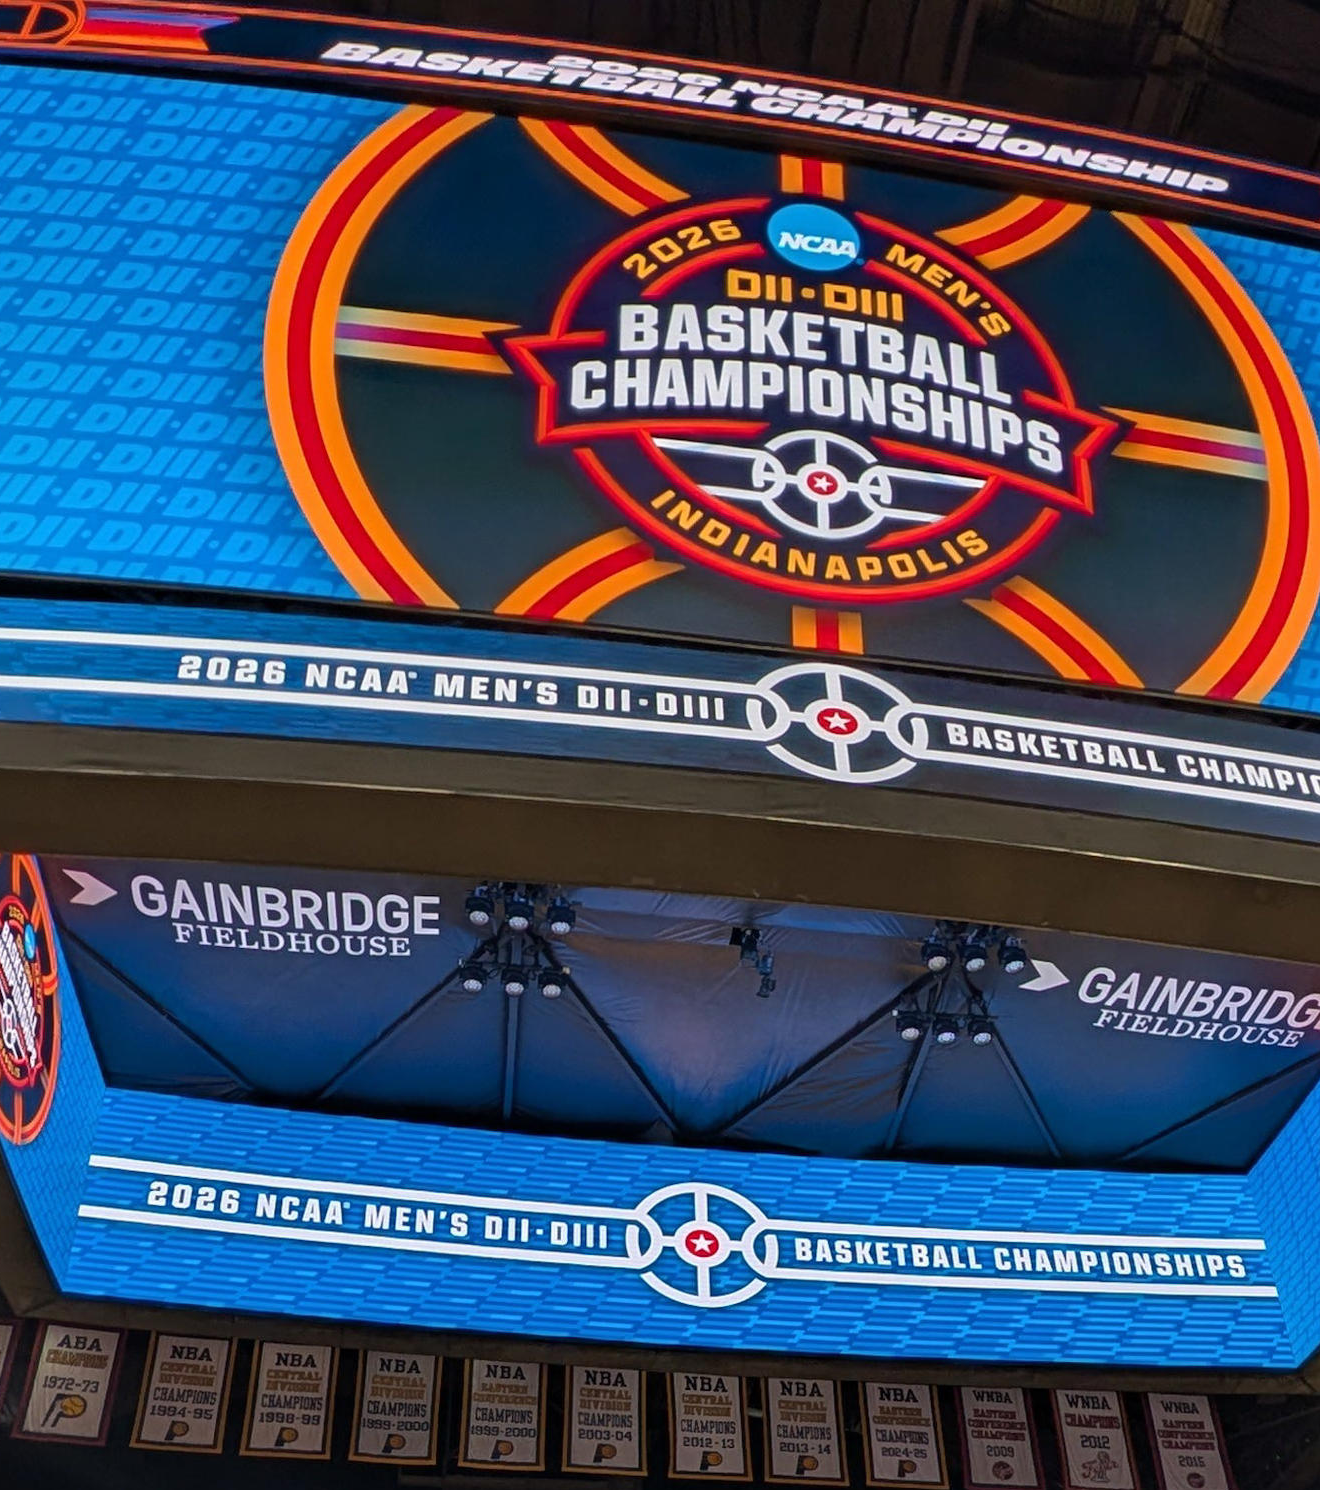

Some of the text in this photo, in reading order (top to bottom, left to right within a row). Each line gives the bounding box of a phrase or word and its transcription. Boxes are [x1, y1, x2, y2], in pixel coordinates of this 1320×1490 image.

[547, 55, 723, 86] 2026
[731, 79, 918, 119] NCAA
[320, 41, 1229, 194] BASKETBALL CHAMPIONSHIP
[623, 219, 742, 280] 2026
[778, 231, 859, 259] NCAA
[885, 243, 1010, 339] MEN'S
[618, 304, 1012, 404] BASKETBALL
[570, 359, 1063, 475] CHAMPIONSHIPS
[651, 489, 989, 582] INDIANAPOLIS
[177, 655, 559, 706] 2026 NCAA MEN'S
[947, 721, 1166, 774] BASKETBALL
[130, 874, 441, 936] GAINBRIDGE
[172, 921, 411, 957] FIELDHOUSE
[1092, 1008, 1305, 1049] FIELDHOUSE
[147, 1181, 468, 1238] 2026 NCAA MEN'S
[794, 1237, 1247, 1279] BASKETBALL CHAMPIONSHIPS
[56, 1334, 103, 1352] ABA
[169, 1345, 213, 1362] NBA
[275, 1352, 317, 1368] NBA
[160, 1361, 218, 1375] CENTRAL
[379, 1357, 422, 1375] NBA
[485, 1364, 526, 1381] NBA
[42, 1375, 100, 1394] 1972-73
[584, 1370, 627, 1387] NBA
[684, 1376, 728, 1393] NBA
[153, 1387, 218, 1405] CHAMPIONS
[780, 1381, 824, 1398] NBA
[879, 1387, 919, 1403] NBA
[973, 1390, 1013, 1404] WNBA
[261, 1393, 323, 1411] CHAMPIONS
[366, 1400, 427, 1418] CHAMPIONS
[1065, 1394, 1112, 1410] WNBA
[1161, 1400, 1199, 1415] WNBA
[149, 1405, 214, 1421] 1994-95
[475, 1407, 533, 1425] CHAMPIONS
[577, 1412, 633, 1429] CHAMPIONS
[577, 1429, 633, 1442] 2003-04
[680, 1419, 736, 1435] CHAMPIONS
[777, 1424, 831, 1441] CHAMPIONS
[875, 1428, 929, 1445] CHAMPIONS
[1081, 1435, 1111, 1450] 2012
